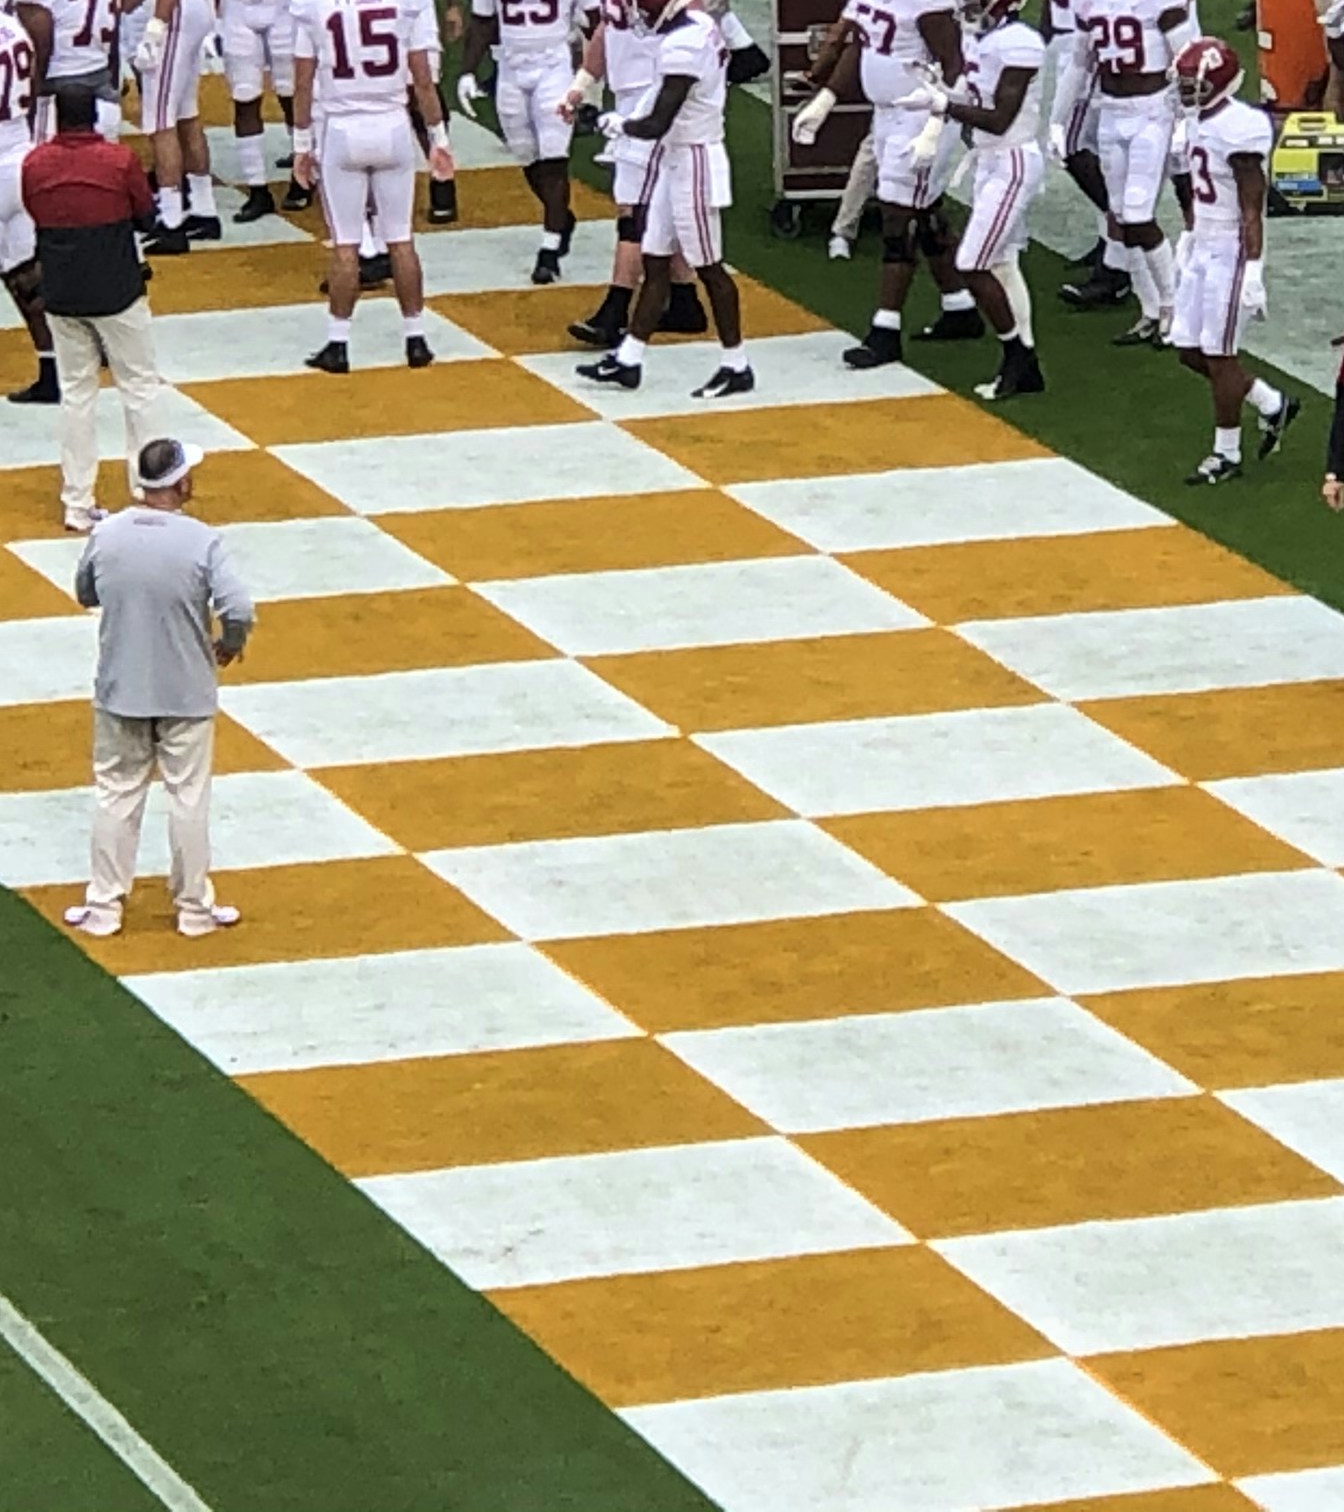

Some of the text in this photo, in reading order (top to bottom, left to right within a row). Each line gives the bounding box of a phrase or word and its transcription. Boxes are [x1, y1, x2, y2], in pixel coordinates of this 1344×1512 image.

[326, 7, 399, 80] 15
[856, 2, 897, 56] 57
[1087, 16, 1145, 73] 29
